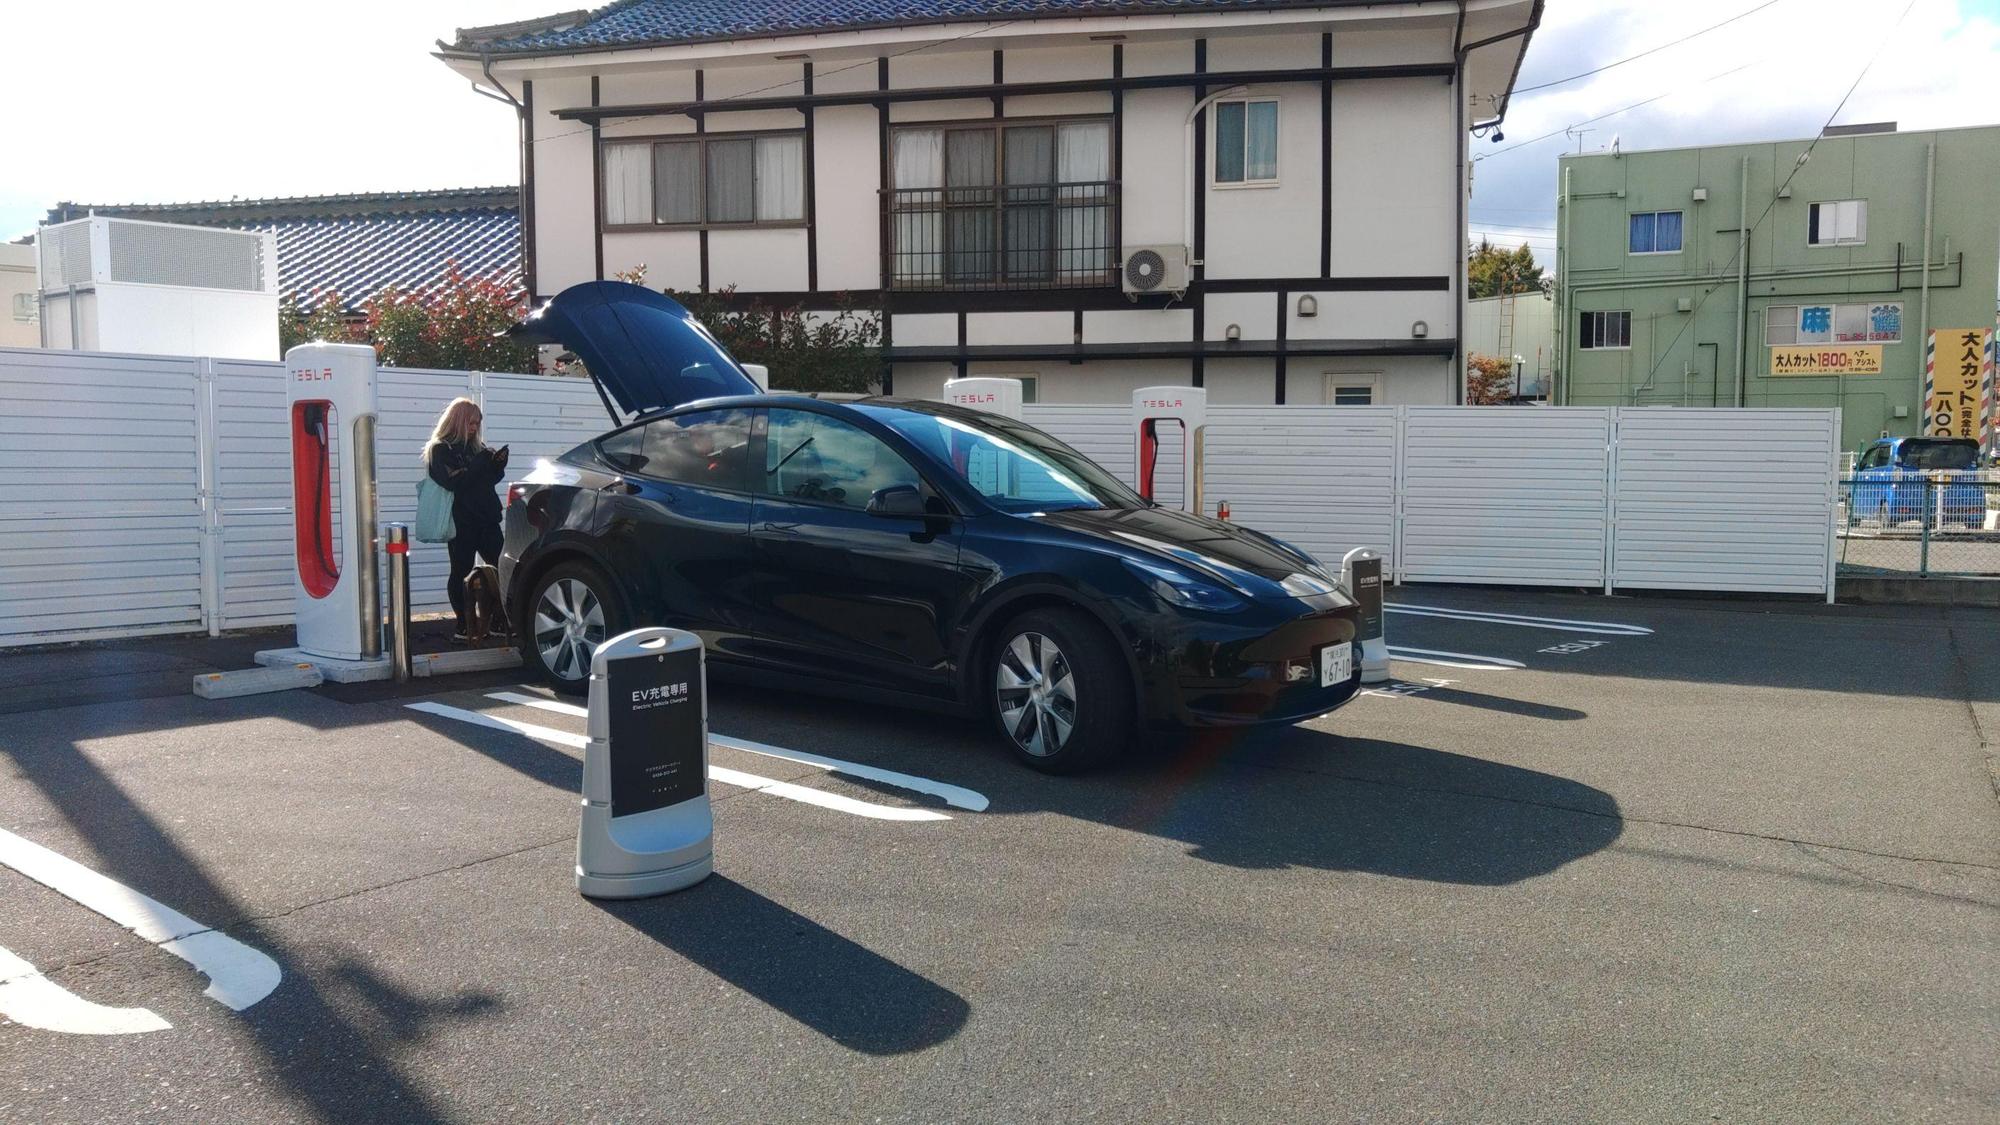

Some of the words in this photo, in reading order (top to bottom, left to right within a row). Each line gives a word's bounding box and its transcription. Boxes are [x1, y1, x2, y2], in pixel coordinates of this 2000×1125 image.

[1855, 358, 1877, 366] アシスト
[291, 368, 332, 381] TESLA
[952, 394, 995, 404] TESLA
[1142, 400, 1182, 408] TESLA
[1328, 658, 1350, 682] 67-10
[632, 682, 688, 702] EV充電専用
